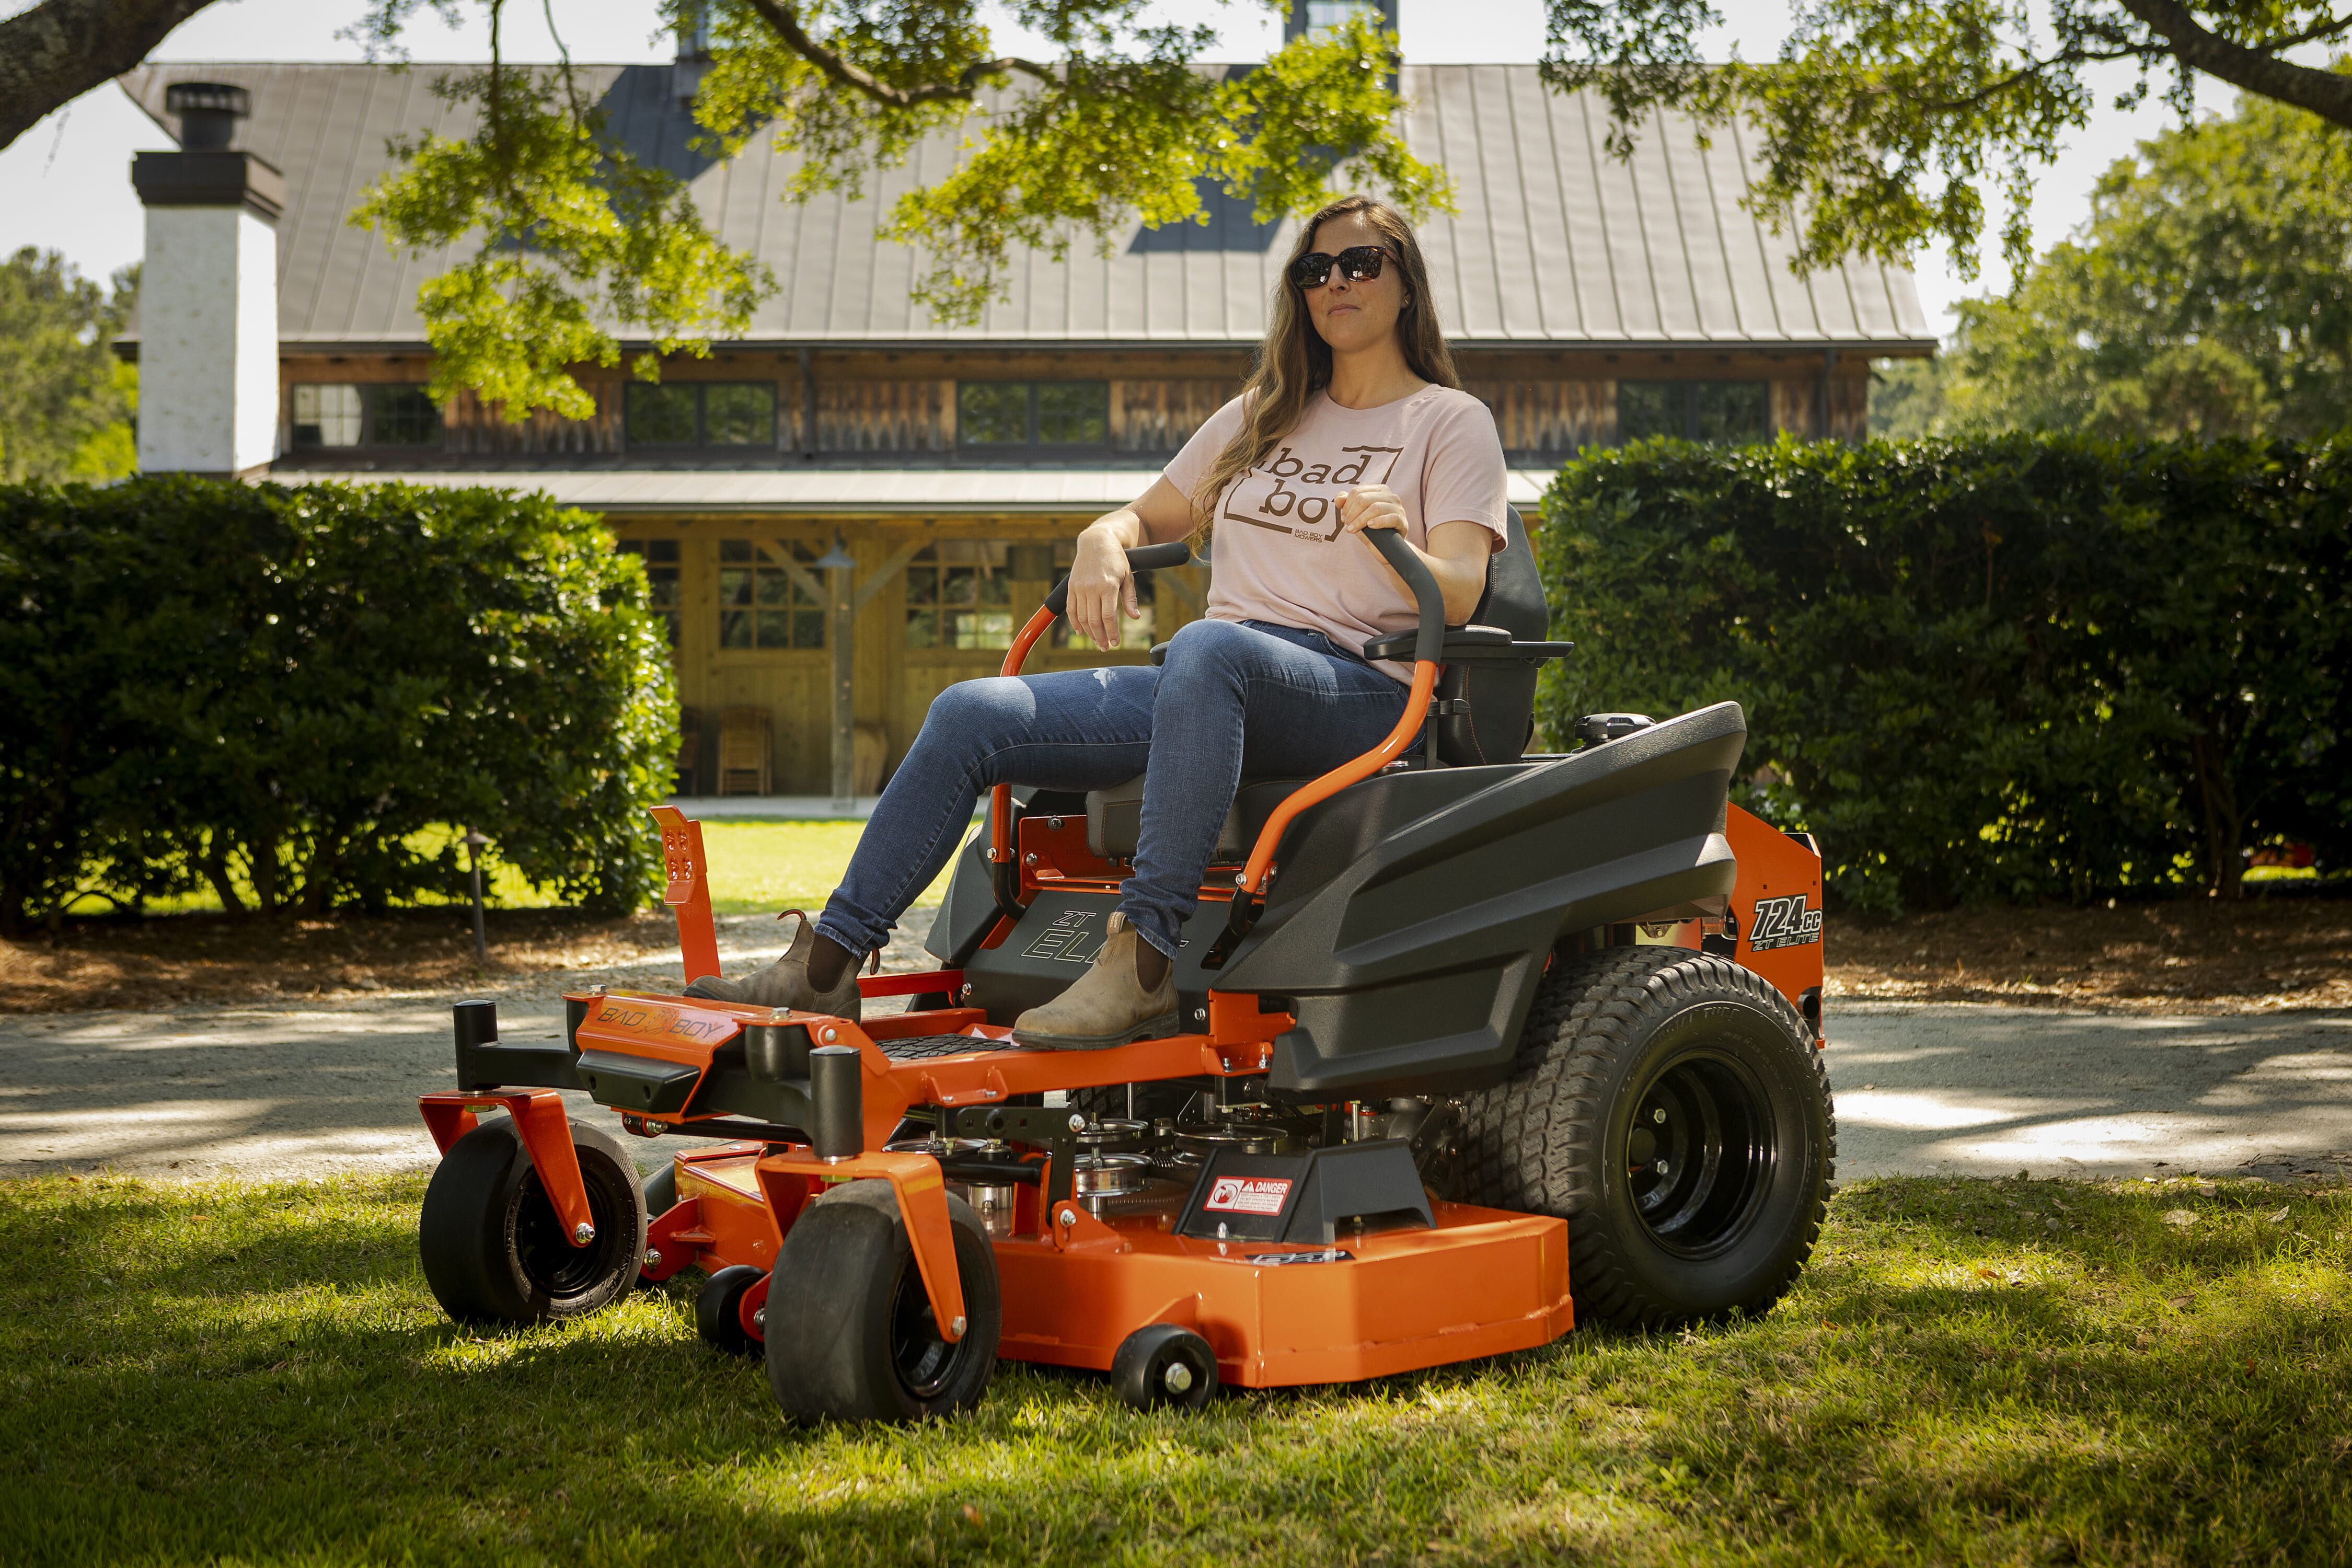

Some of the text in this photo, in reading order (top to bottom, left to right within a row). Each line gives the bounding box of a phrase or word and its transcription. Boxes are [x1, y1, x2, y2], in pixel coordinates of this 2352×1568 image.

[1264, 447, 1372, 485] bad
[1295, 533, 1322, 543] MOWERS
[1052, 910, 1097, 927] ZT
[1753, 932, 1819, 951] ZT ELITE
[597, 1008, 724, 1038] BAD BOY
[1255, 1182, 1288, 1194] DANGER
